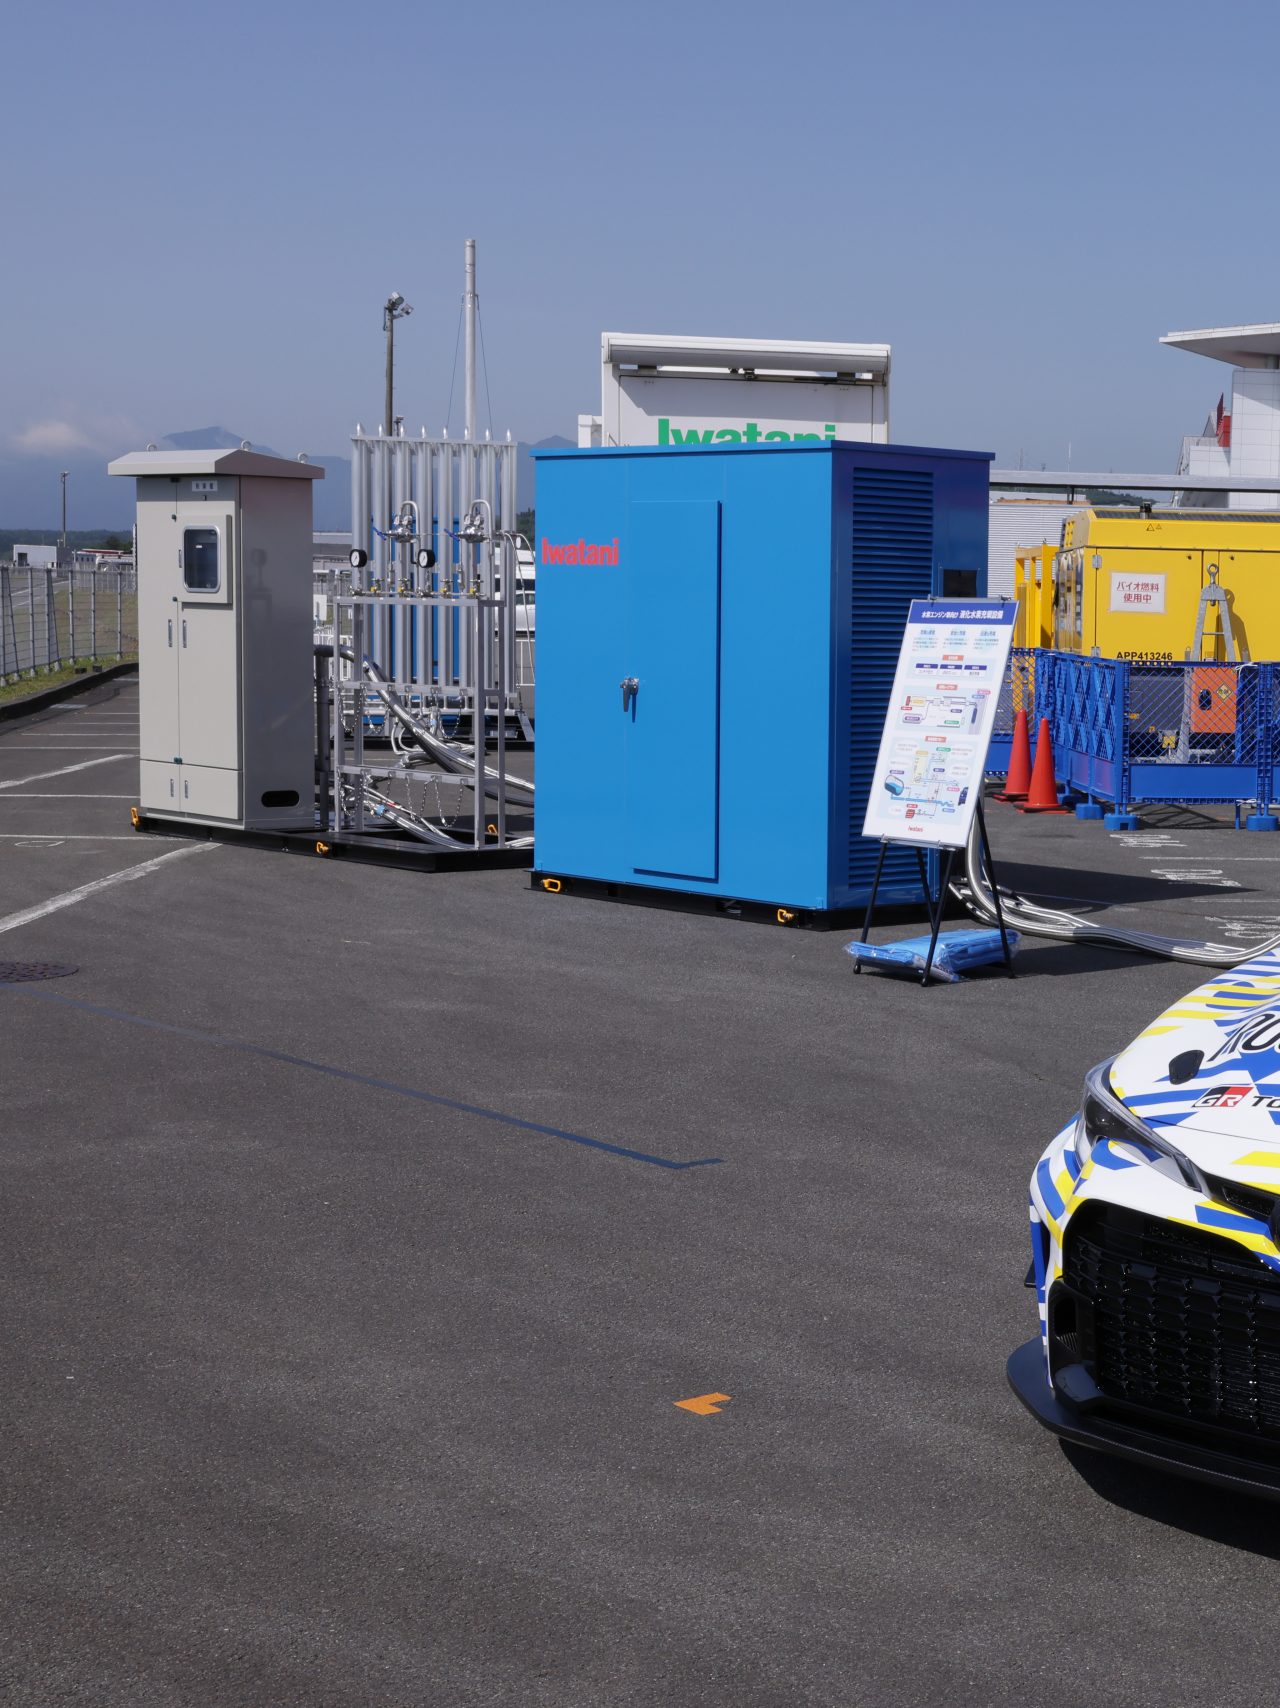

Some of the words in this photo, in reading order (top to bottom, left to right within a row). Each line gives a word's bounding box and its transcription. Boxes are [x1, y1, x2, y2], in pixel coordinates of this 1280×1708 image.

[541, 537, 619, 565] Iwatani
[1116, 581, 1160, 592] バイオ燃料
[1123, 592, 1152, 604] 使用中
[1116, 651, 1173, 661] APP413246
[1199, 1094, 1244, 1107] GR
